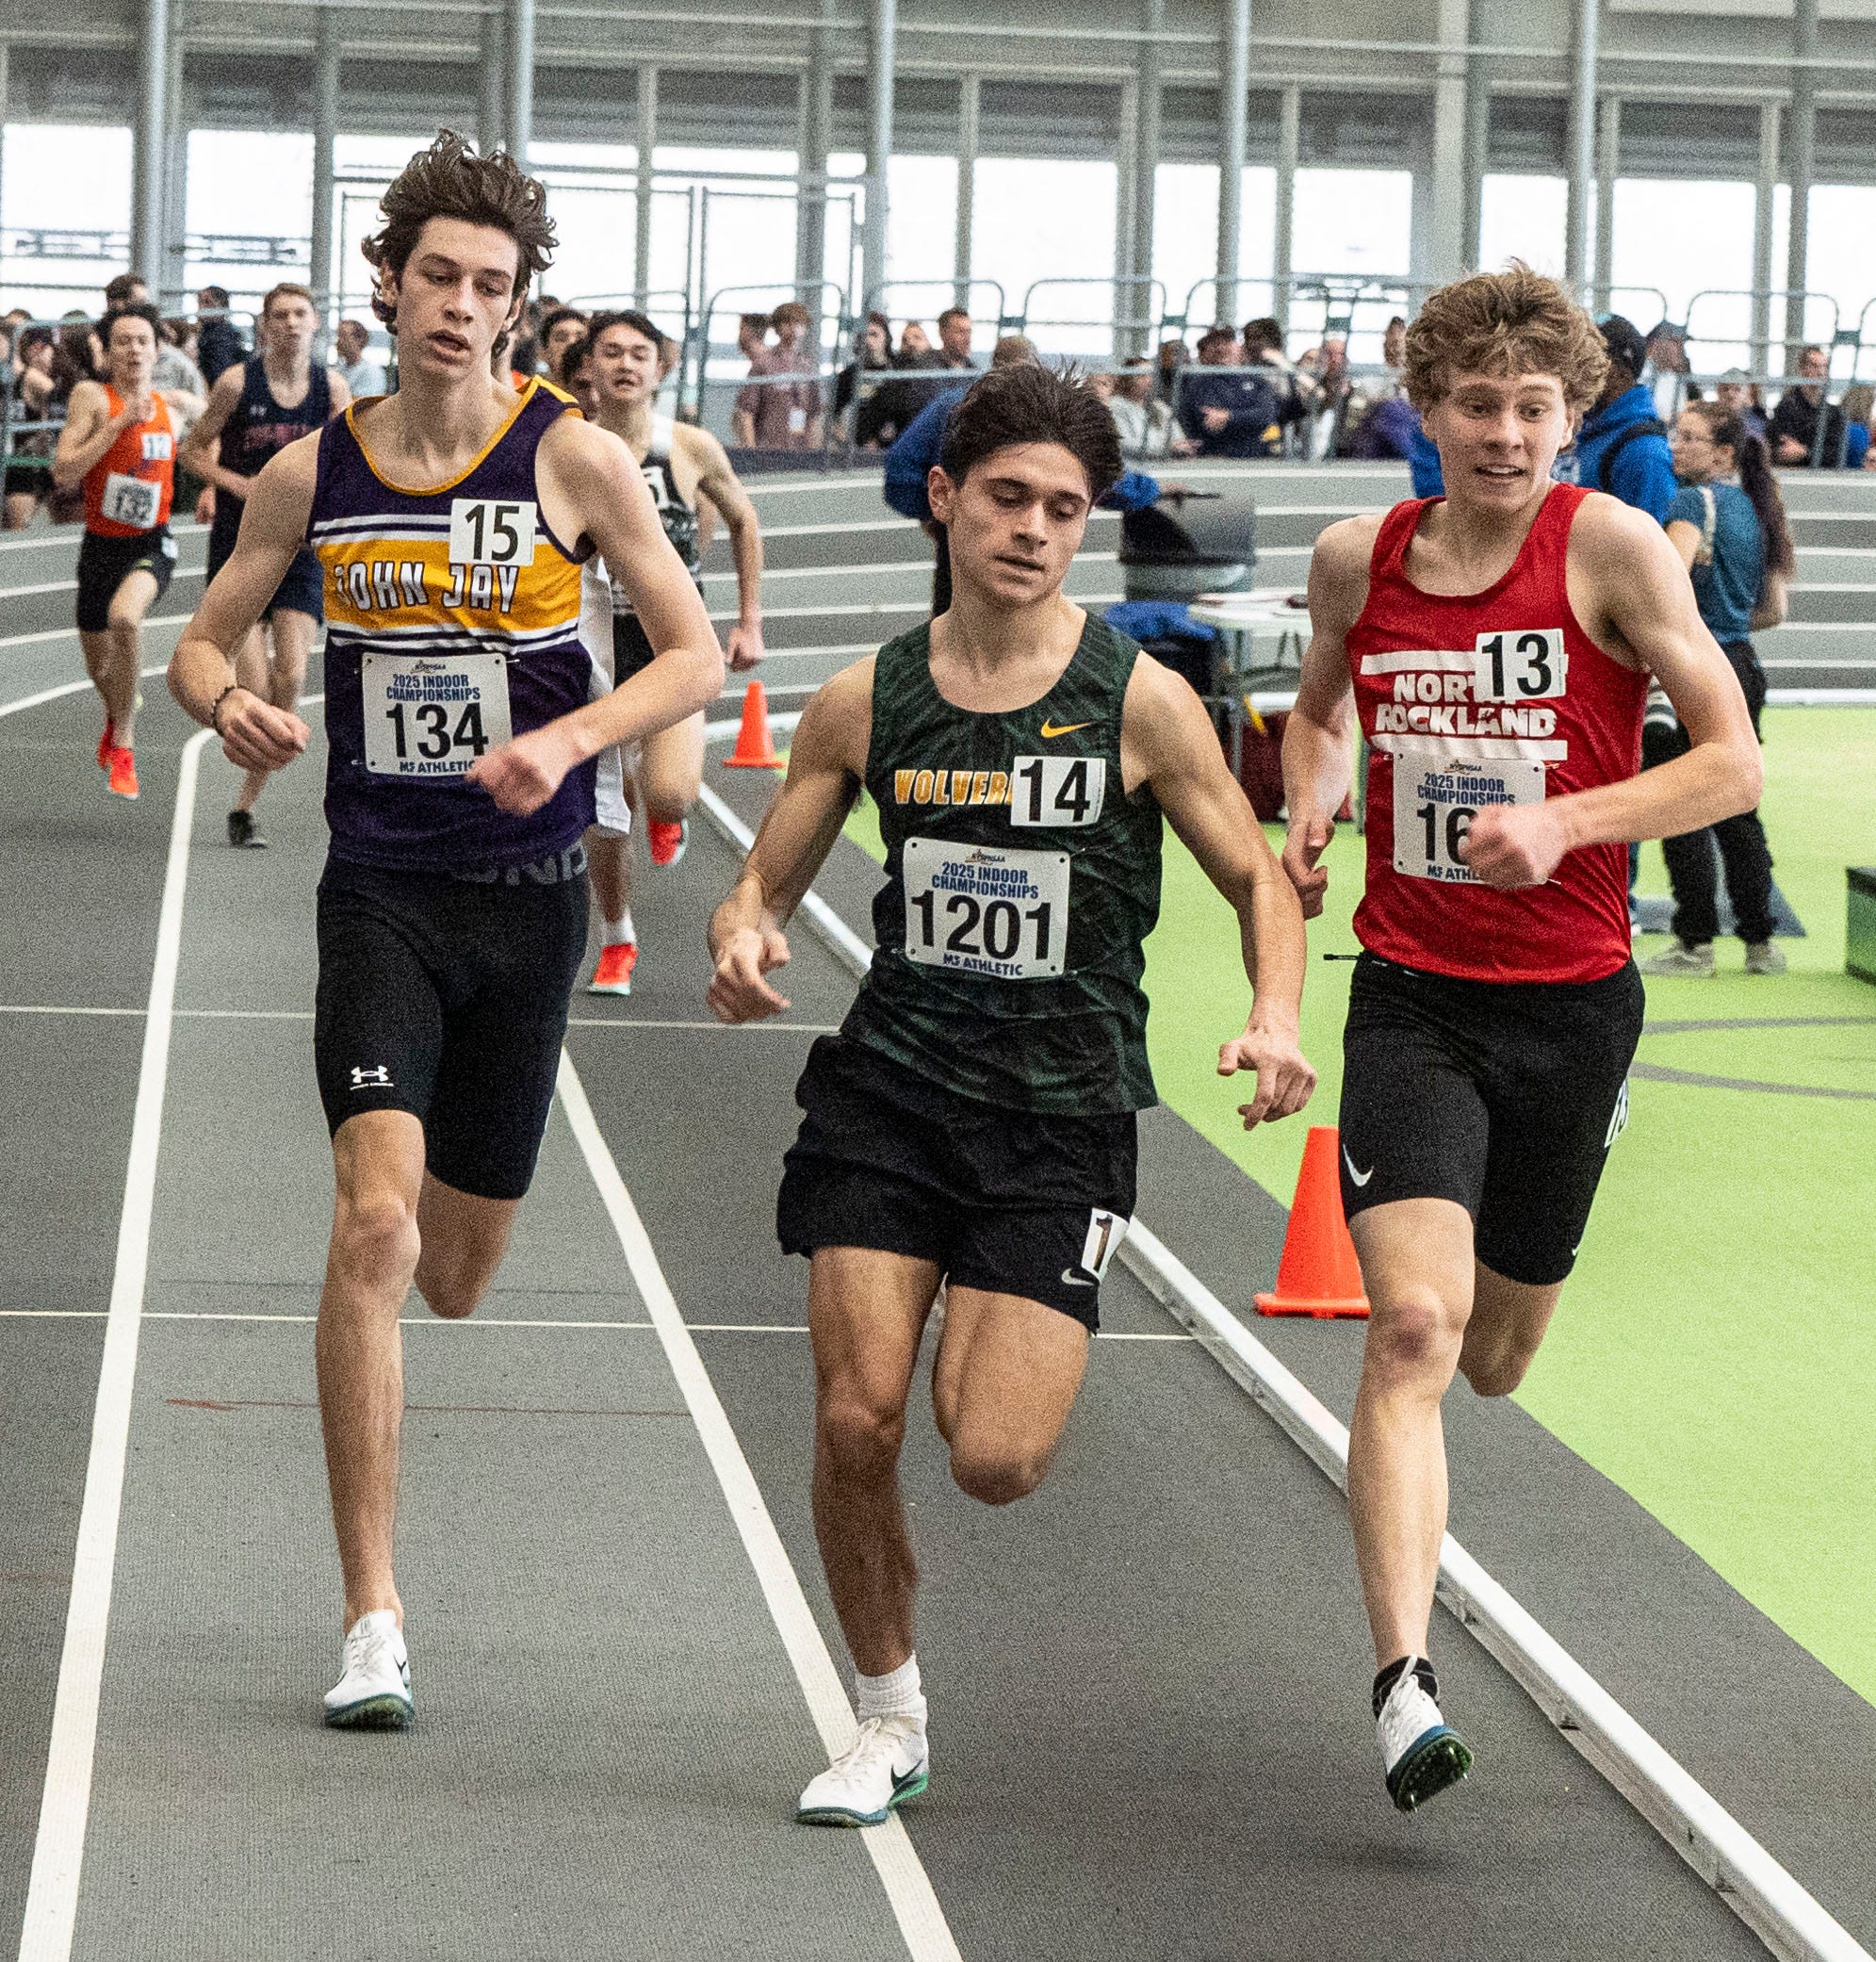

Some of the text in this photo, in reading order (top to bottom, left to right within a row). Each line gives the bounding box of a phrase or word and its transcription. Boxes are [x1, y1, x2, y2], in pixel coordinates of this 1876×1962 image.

[465, 504, 520, 562] 15
[441, 564, 519, 613] JAY
[1481, 633, 1552, 696] 13
[386, 686, 481, 701] CHAMPIONSHIPS
[392, 673, 468, 688] 2025 INDOOR
[1394, 673, 1513, 704] NOR
[386, 702, 489, 760] 134
[1375, 703, 1558, 738] ROCKLAND
[1020, 759, 1091, 824] 14
[1417, 785, 1516, 806] CHAMPIONSHIPS
[1424, 772, 1505, 793] 2025 INDOOR
[1416, 802, 1478, 866] 16
[931, 875, 1039, 899] CHAMPIONSHIPS
[942, 861, 1028, 884] 2025 INDOOR
[1444, 867, 1483, 881] ATHL
[911, 890, 1052, 960] 1201
[963, 956, 1023, 976] ATHLETIC
